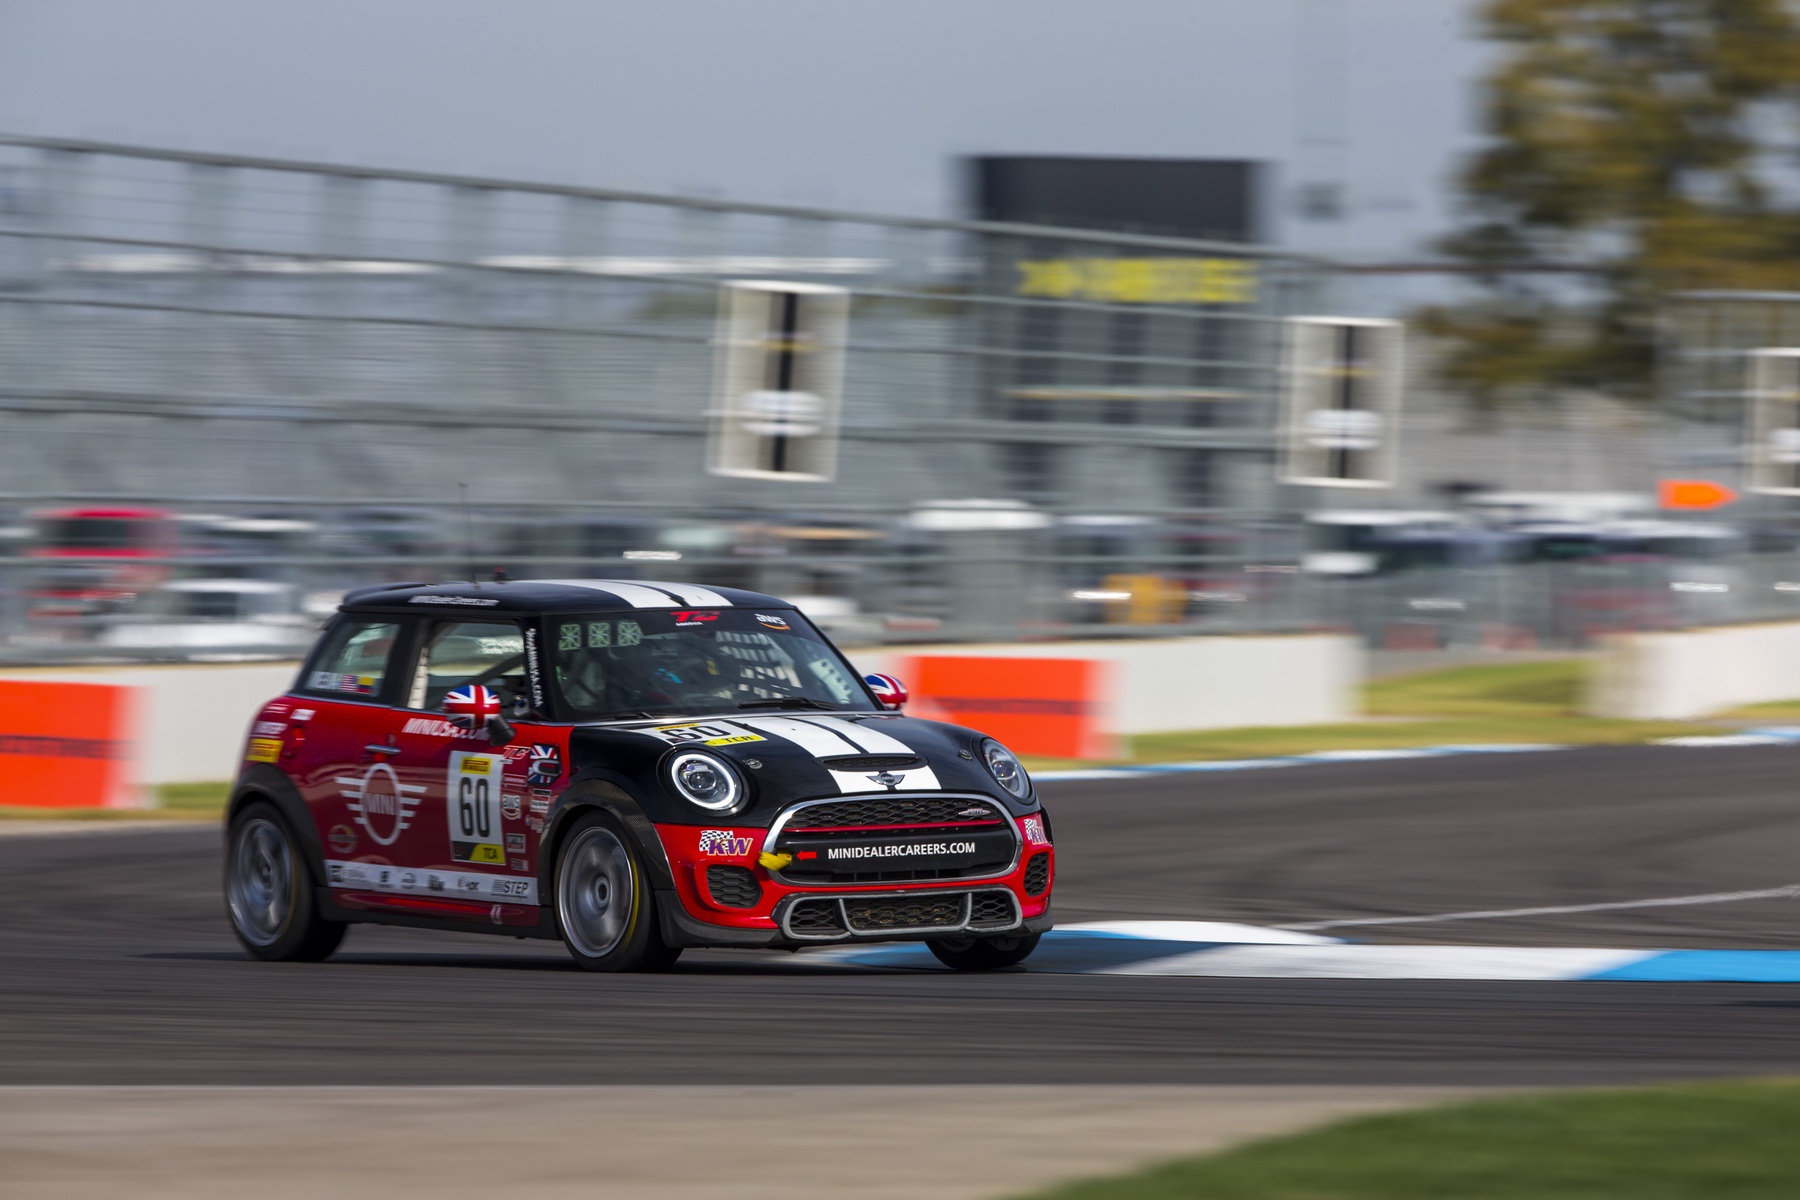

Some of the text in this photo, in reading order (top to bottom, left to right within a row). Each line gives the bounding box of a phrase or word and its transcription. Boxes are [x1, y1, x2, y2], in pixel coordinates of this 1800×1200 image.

[754, 613, 787, 625] aws
[660, 725, 731, 740] 60
[724, 735, 754, 744] TCA
[364, 793, 398, 816] MINI
[459, 777, 489, 838] 60
[502, 794, 522, 810] aws
[1030, 827, 1048, 846] KW
[482, 847, 499, 860] TCA
[707, 838, 753, 856] KW
[828, 842, 976, 860] MINIDEALERCAREERS.COM
[503, 880, 529, 895] STEP
